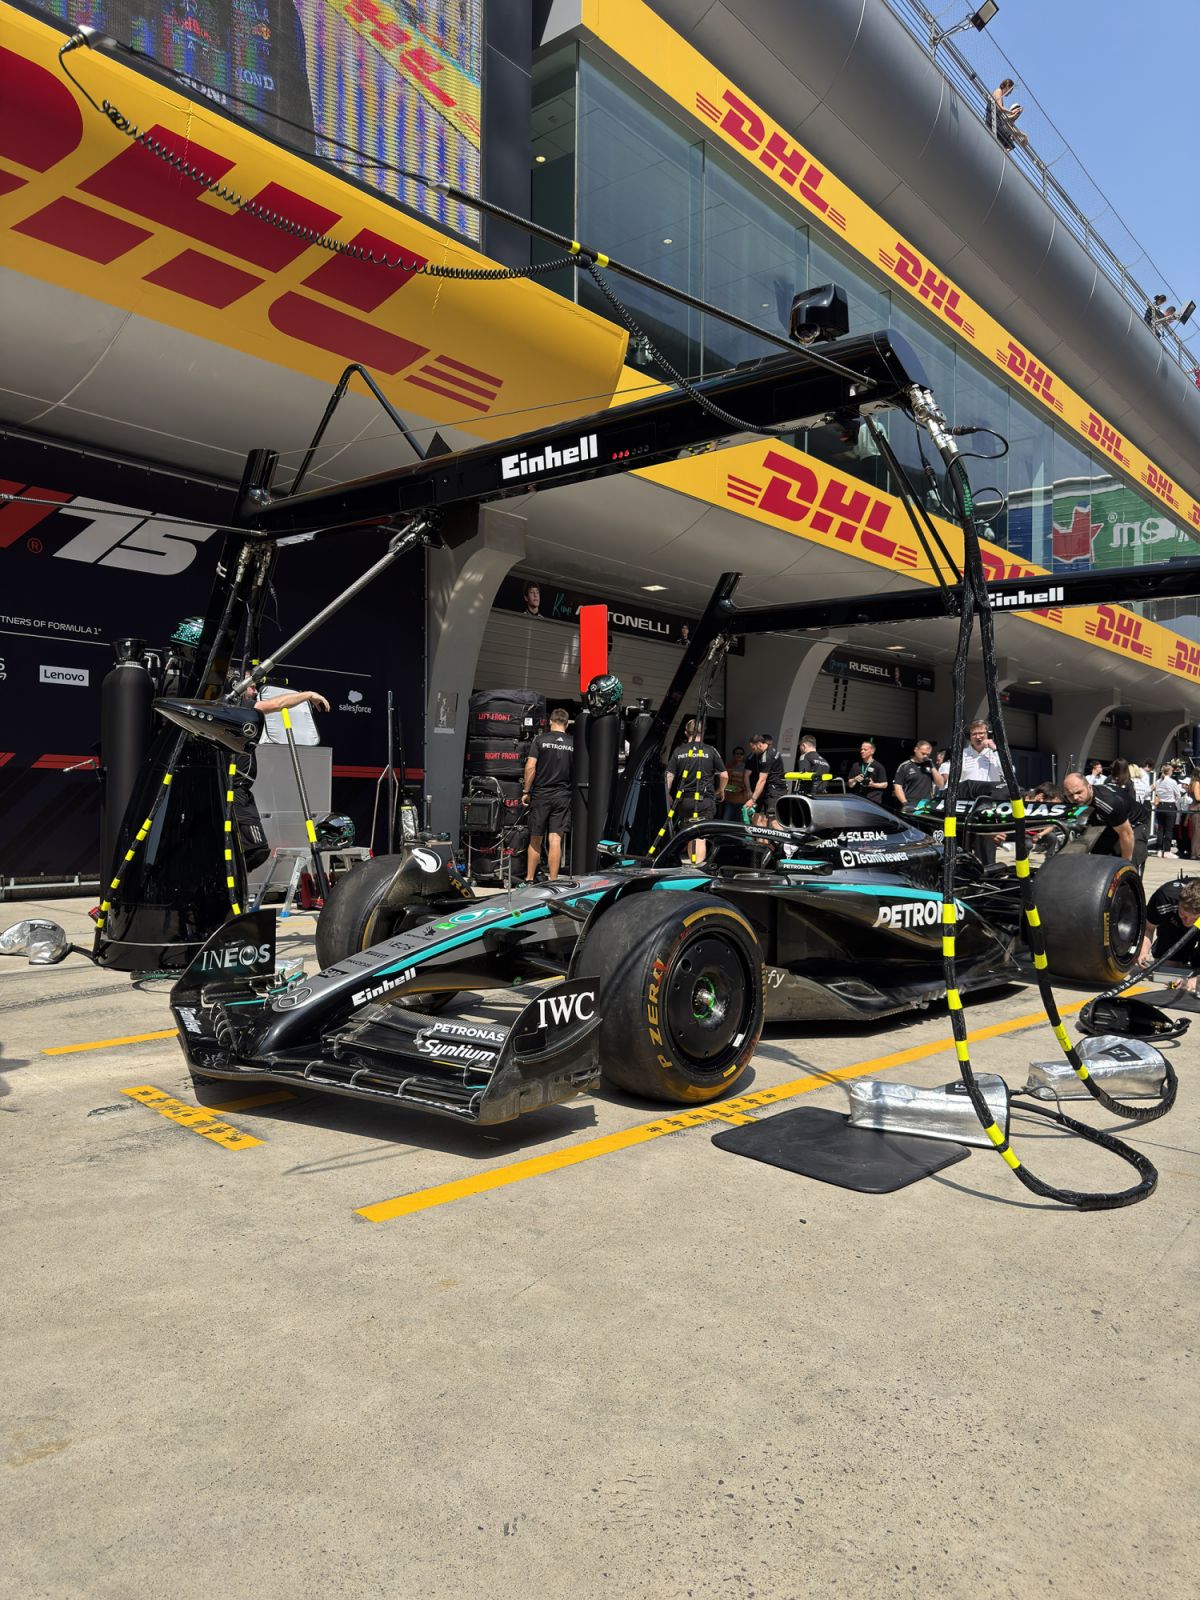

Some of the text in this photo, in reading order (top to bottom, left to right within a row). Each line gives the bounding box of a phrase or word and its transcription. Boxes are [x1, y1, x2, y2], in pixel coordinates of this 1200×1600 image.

[720, 89, 829, 214] DHL
[894, 242, 964, 328] DHL
[1007, 341, 1055, 405] DHL
[1087, 412, 1123, 462] DHL
[501, 433, 598, 480] Einhell
[1146, 464, 1174, 504] DHL
[758, 450, 897, 559] DHL
[33, 619, 46, 628] OF
[47, 621, 92, 634] FORMULA
[575, 605, 670, 635] TONELLI
[1095, 604, 1144, 656] DHL
[849, 661, 890, 677] RUSSELL
[1175, 640, 1200, 677] DH
[44, 669, 85, 682] Lenovo
[338, 703, 372, 714] salesforce
[491, 713, 511, 721] FRONT
[485, 752, 500, 760] RIGHT
[748, 827, 791, 839] CROWDSTRIKE
[846, 832, 881, 842] SOLERA
[855, 851, 909, 866] TeamViewer
[201, 943, 271, 971] INEOS
[352, 967, 417, 1007] Einhell
[537, 991, 596, 1029] IWC
[433, 1022, 506, 1043] PETRONAS
[419, 1039, 496, 1062] Syntium
[656, 1054, 673, 1069] P
